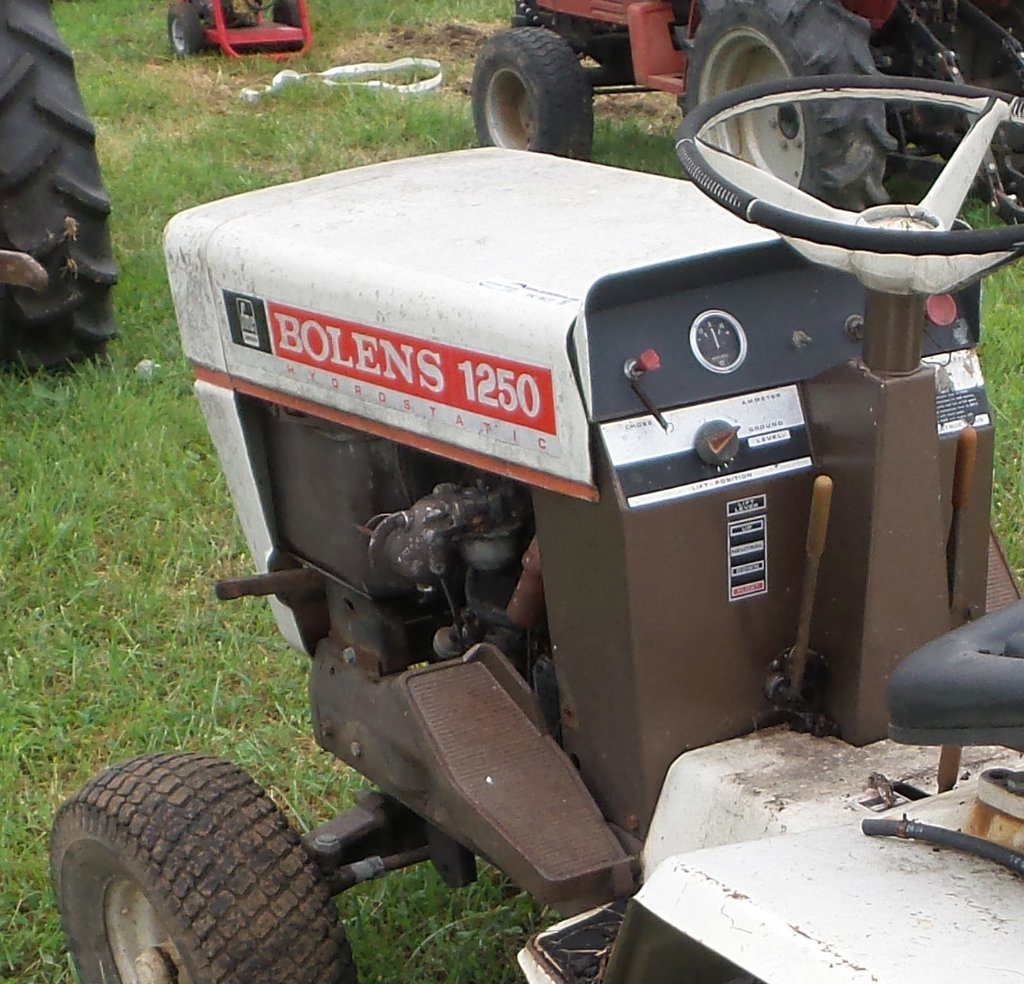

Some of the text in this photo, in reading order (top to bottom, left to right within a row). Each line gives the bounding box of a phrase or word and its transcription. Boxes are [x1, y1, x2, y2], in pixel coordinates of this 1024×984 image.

[274, 311, 541, 418] BOLENS 1250
[287, 365, 546, 450] HYDROSTATIC
[742, 392, 781, 406] AMMETER
[749, 420, 784, 432] GROUND
